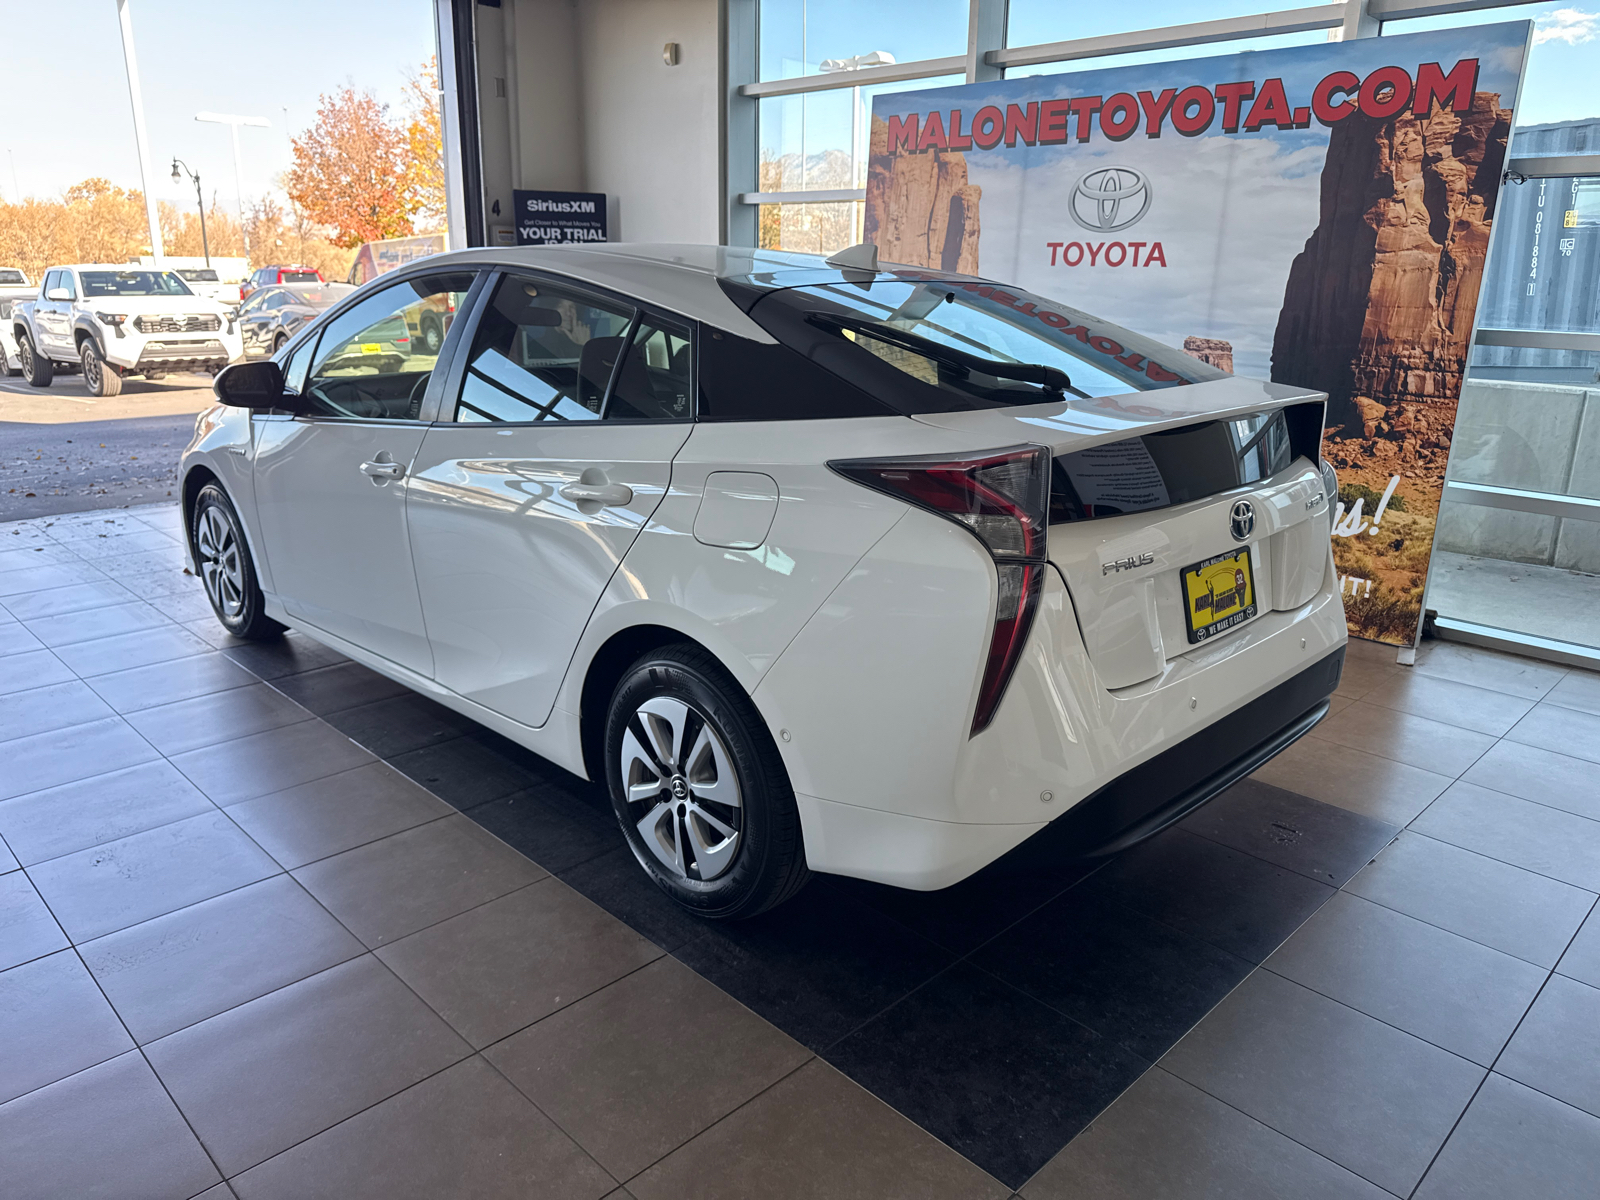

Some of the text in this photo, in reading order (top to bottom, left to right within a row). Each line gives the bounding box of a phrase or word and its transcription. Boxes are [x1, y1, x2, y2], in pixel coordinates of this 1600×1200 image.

[886, 57, 1480, 155] MALONETOYOTA.COM
[491, 199, 501, 217] 4
[526, 200, 596, 214] SiriusXM
[519, 227, 562, 240] YOUR
[564, 228, 607, 241] TRIAL
[1530, 211, 1543, 279] 081884
[1561, 249, 1572, 257] 70
[1046, 241, 1168, 268] TOYOTA
[1102, 551, 1155, 577] PRIUS
[1217, 619, 1229, 631] MAKE
